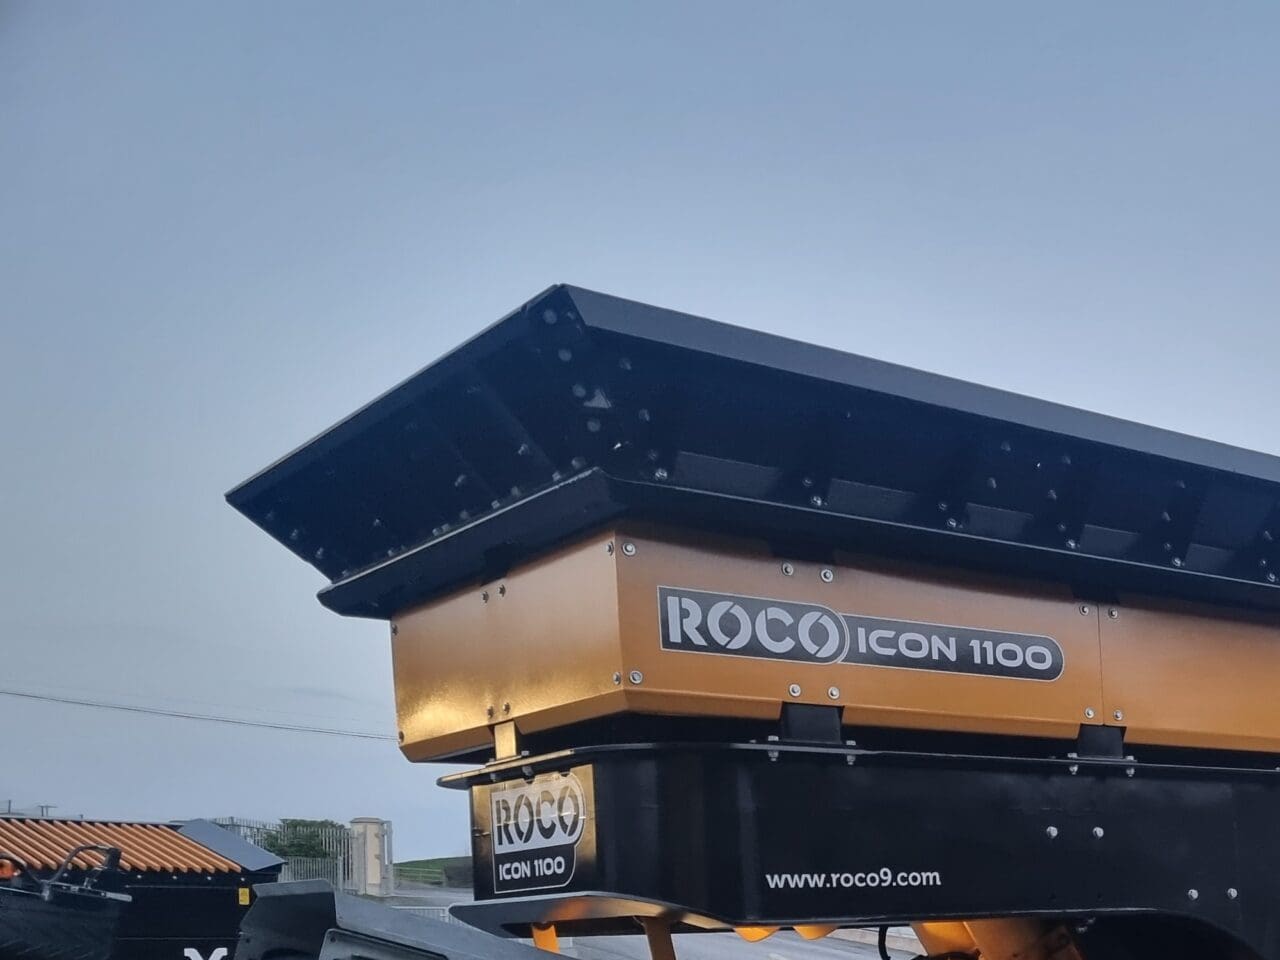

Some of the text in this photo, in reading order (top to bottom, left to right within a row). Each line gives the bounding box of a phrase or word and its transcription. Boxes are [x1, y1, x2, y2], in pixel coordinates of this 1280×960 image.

[667, 596, 1053, 671] ROCO ICON 1100
[496, 785, 580, 846] ROCO
[498, 855, 566, 881] ICON 1100
[765, 867, 943, 889] www.roco9.com
